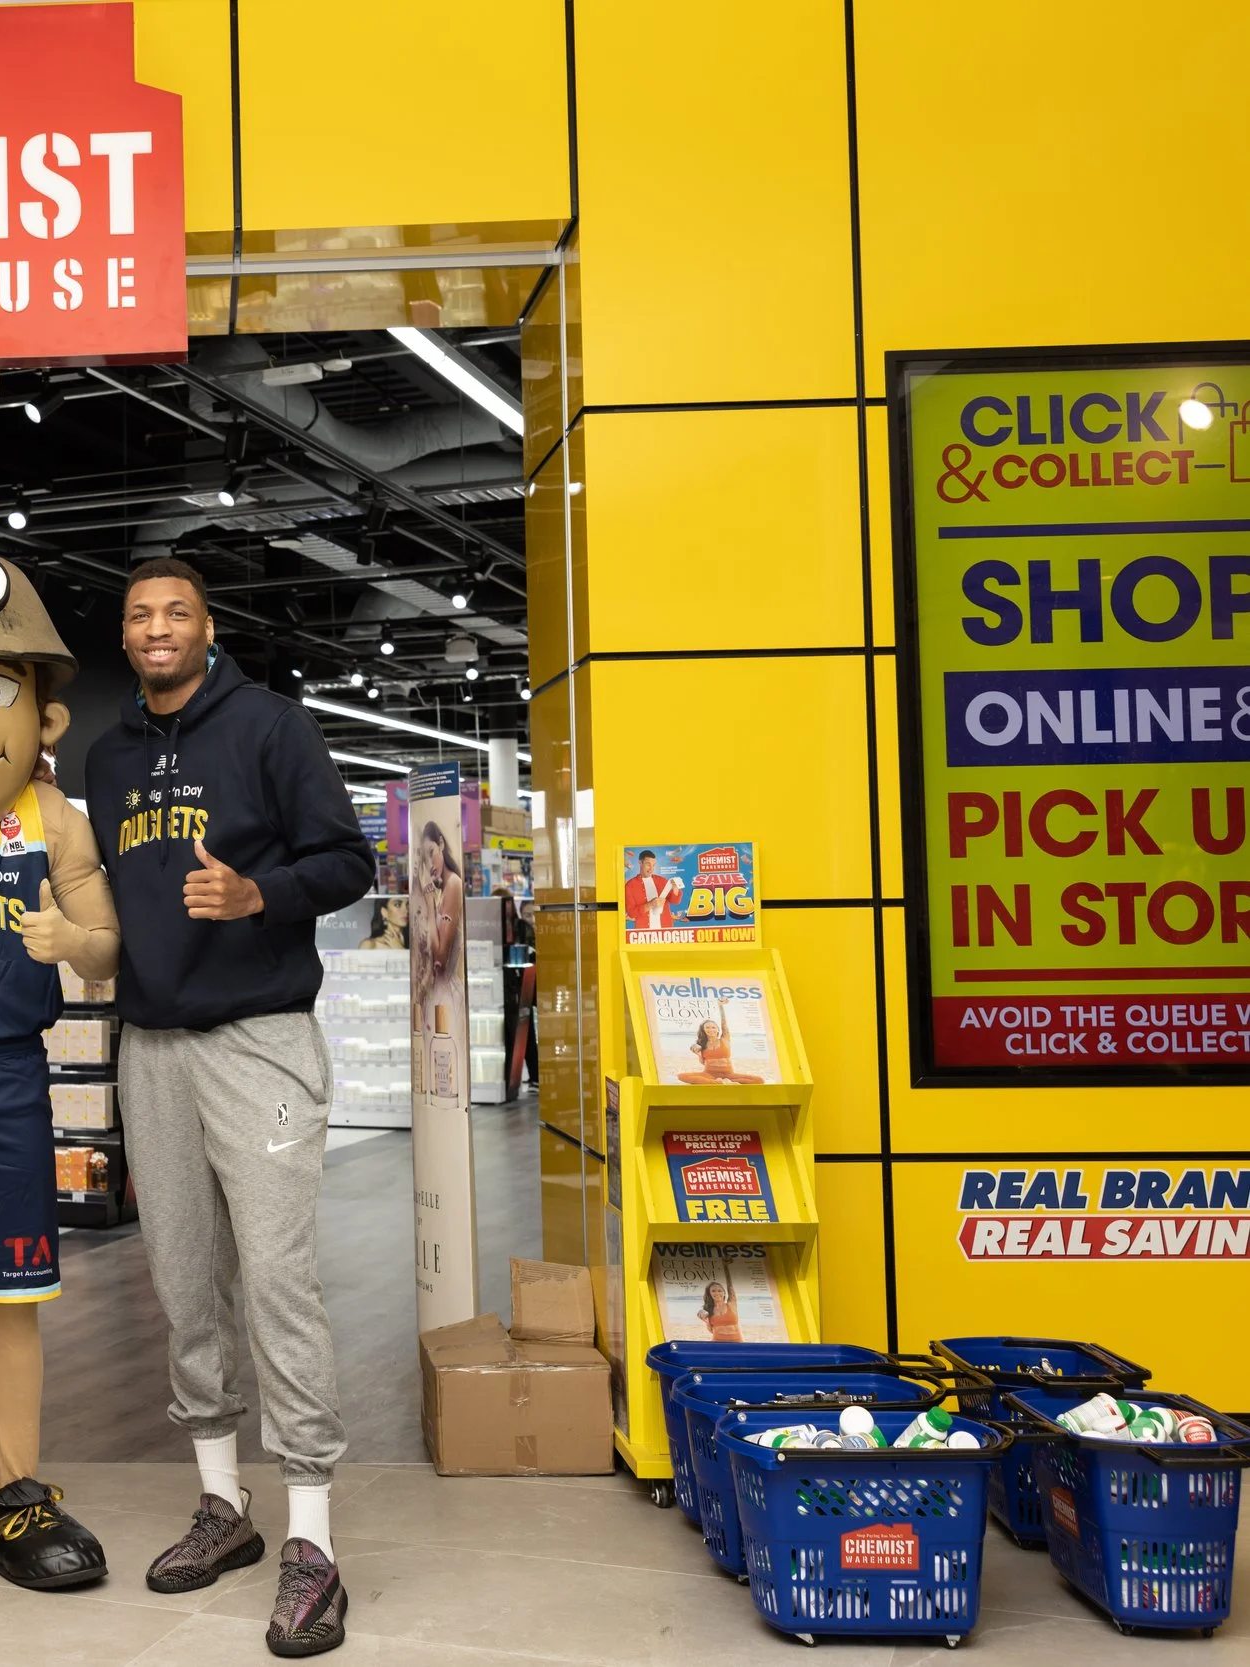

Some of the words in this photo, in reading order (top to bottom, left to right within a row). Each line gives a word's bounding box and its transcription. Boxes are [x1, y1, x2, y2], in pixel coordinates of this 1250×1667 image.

[960, 391, 1169, 447] CLICK
[965, 687, 1223, 747] ONLINE
[182, 785, 203, 798] Day
[947, 788, 1164, 859] PICK
[9, 841, 25, 850] NBL
[701, 856, 736, 865] CHEMIST
[692, 873, 747, 886] SAVE
[687, 886, 755, 919] BIG
[951, 884, 1033, 948] IN
[629, 930, 695, 944] CATALOGUE
[696, 929, 720, 943] OUT
[722, 927, 755, 942] NOW!
[650, 977, 762, 999] wellness
[960, 1006, 1052, 1029] AVOID
[1060, 1006, 1116, 1028] THE
[1125, 1004, 1227, 1028] QUEUE
[1005, 1032, 1089, 1055] CLICK
[1097, 1033, 1118, 1055] &
[672, 1134, 752, 1142] PRESCRIPTION
[687, 1170, 752, 1183] CHEMIST
[959, 1170, 1089, 1210] REAL
[686, 1199, 770, 1220] FREE
[971, 1220, 1092, 1256] REAL
[4, 1235, 52, 1267] TA
[654, 1242, 766, 1258] wellness
[663, 1269, 716, 1281] GLOW!
[845, 1539, 915, 1555] CHEMIST
[845, 1556, 913, 1565] WAREHOUSE
